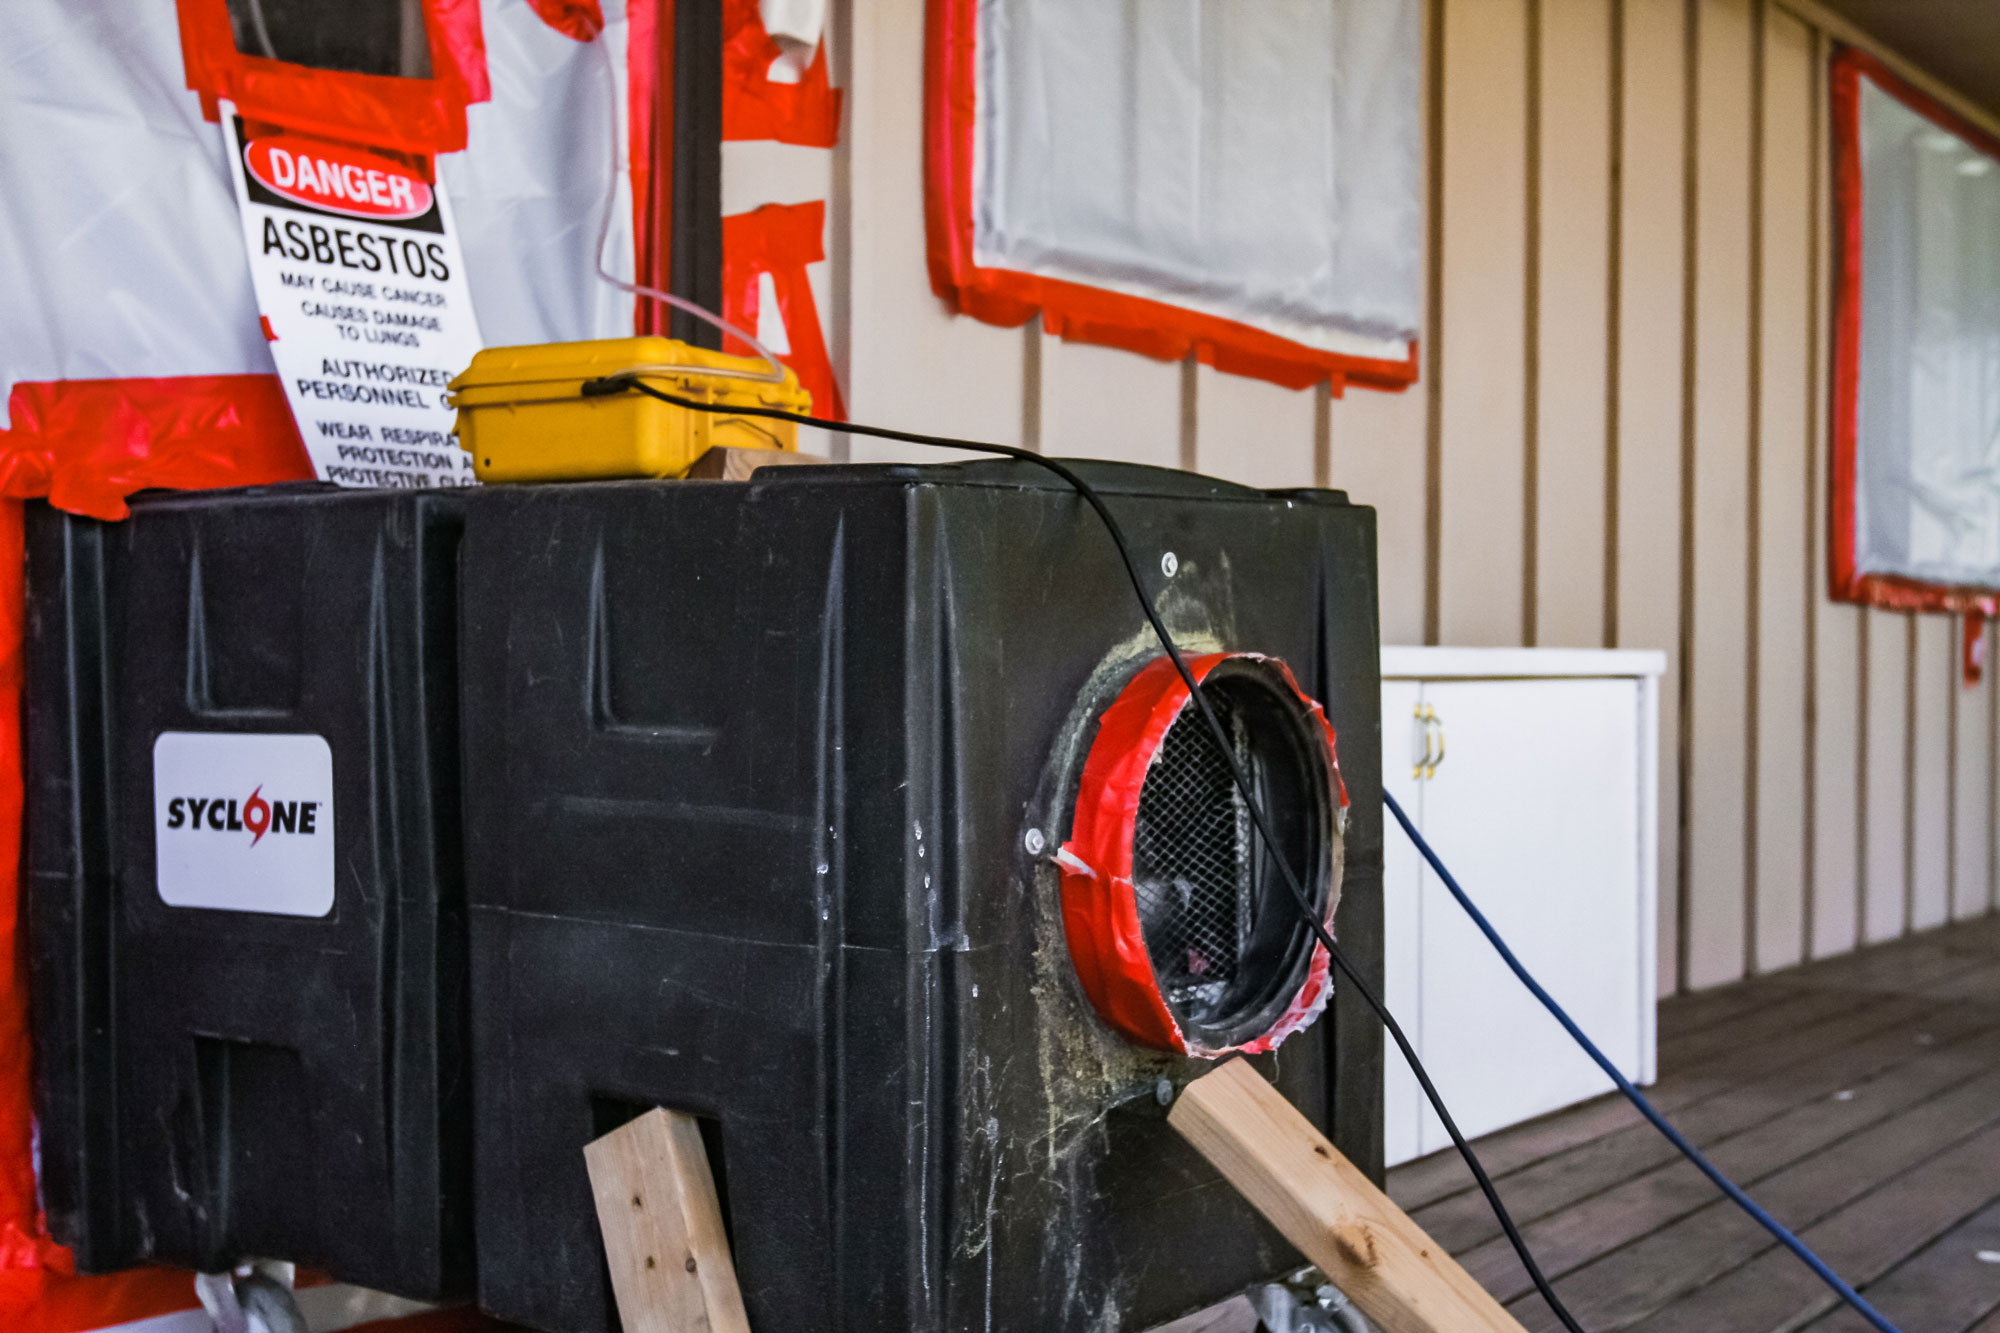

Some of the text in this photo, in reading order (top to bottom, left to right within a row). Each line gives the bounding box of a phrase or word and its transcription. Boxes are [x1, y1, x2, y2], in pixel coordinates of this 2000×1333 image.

[268, 147, 415, 211] DANGER
[263, 216, 449, 281] ASBESTOS
[281, 272, 446, 307] MAY CAUSE CANCER
[301, 301, 442, 332] CAUSES DAMAGE
[337, 324, 420, 348] TO LUNGS
[322, 357, 456, 387] AUTHORIZED
[297, 380, 430, 410] PERSONNEL
[315, 420, 372, 441] WEAR
[337, 444, 453, 470] PROTECTION
[325, 464, 429, 488] PROTECTIVE
[167, 783, 323, 848] SYCLONE
